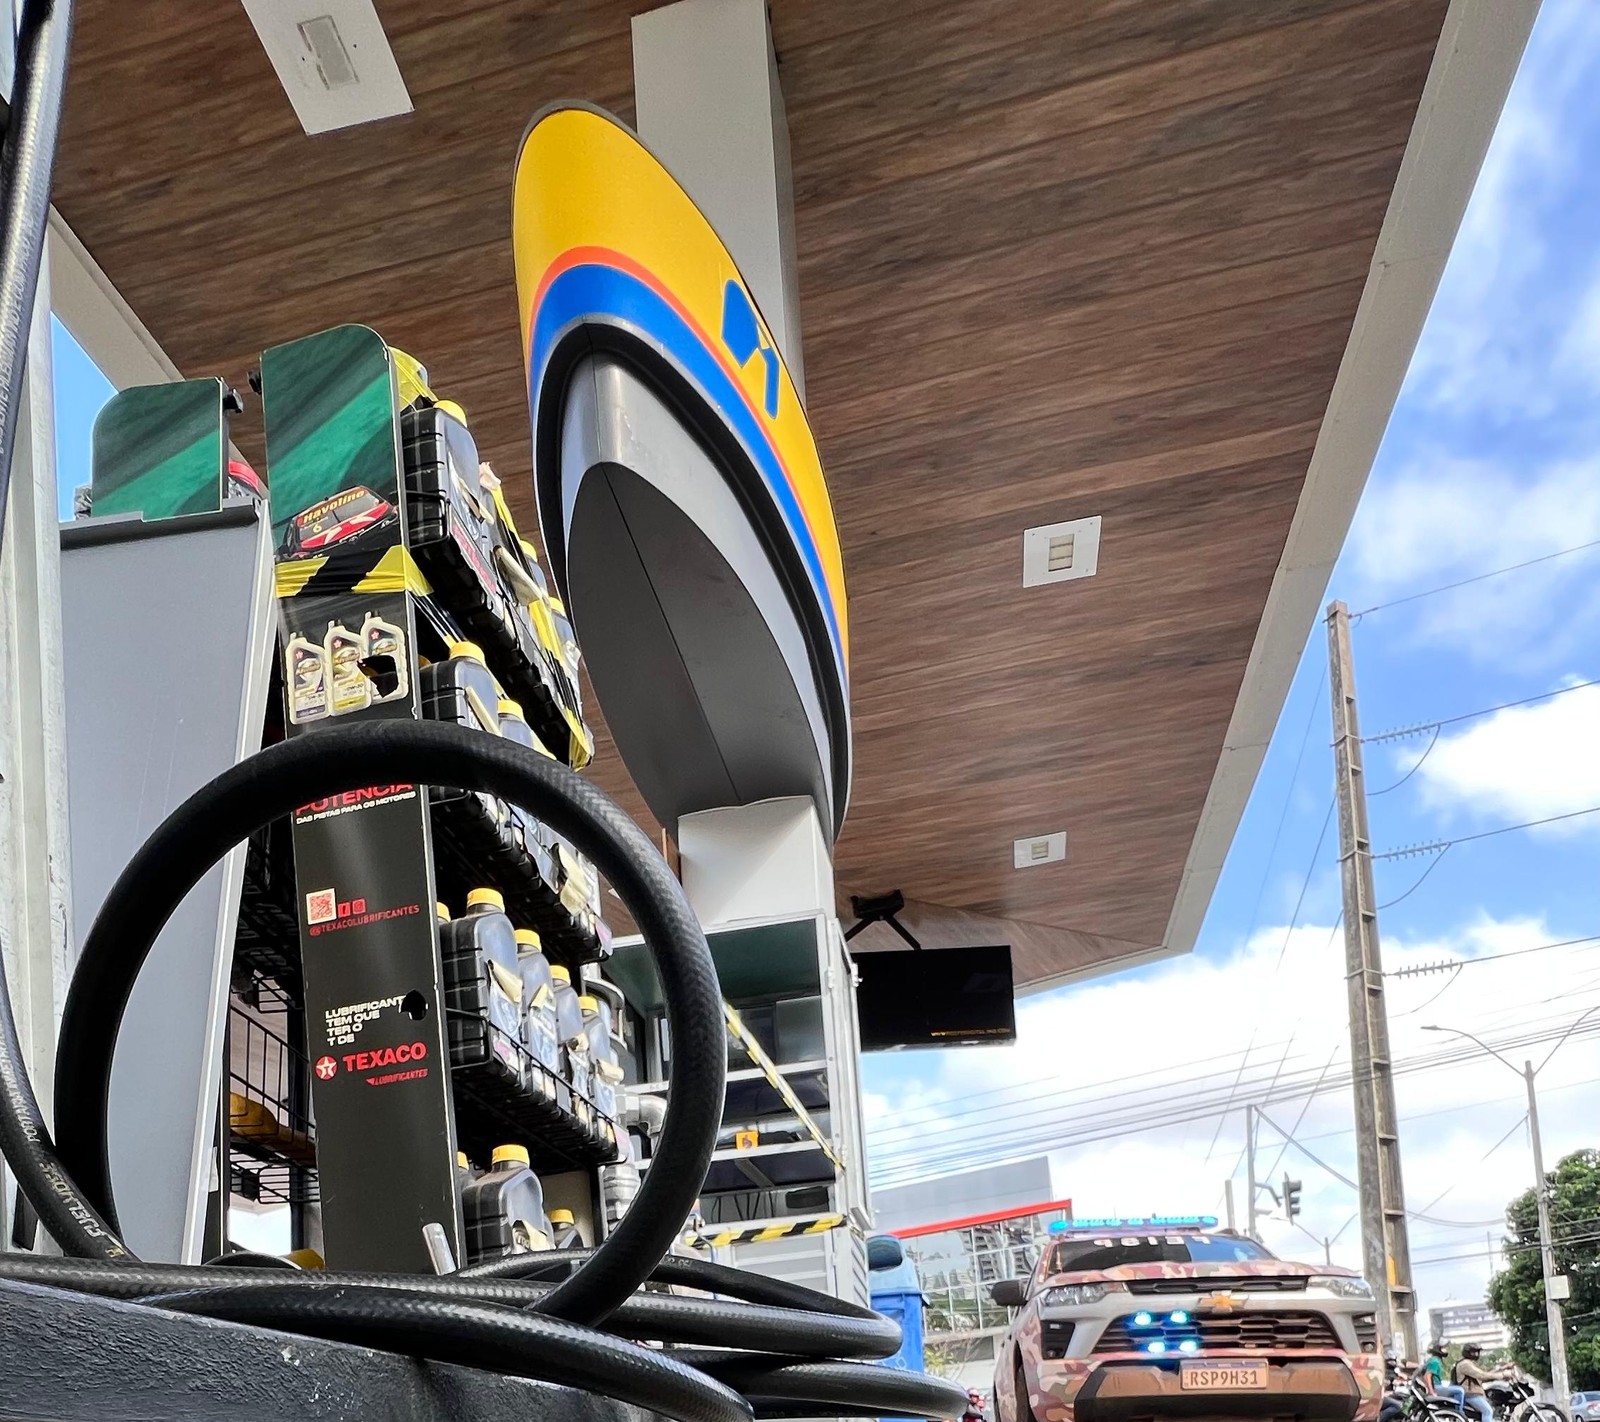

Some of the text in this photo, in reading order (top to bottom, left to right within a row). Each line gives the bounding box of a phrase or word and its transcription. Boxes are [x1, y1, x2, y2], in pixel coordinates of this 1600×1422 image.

[303, 490, 365, 524] Havoline
[313, 523, 323, 533] 6
[296, 791, 417, 824] DAS PISTAS PARA OS MOTORES
[309, 904, 420, 936] @TEXACOLUBRIFICANTES
[325, 995, 407, 1019] LUBRIFICANT
[326, 1009, 380, 1028] TEM QUE
[326, 1023, 363, 1037] TER O
[327, 1033, 355, 1047] T DE
[343, 1041, 427, 1072] TEXACO
[373, 1068, 428, 1086] LUBRIFICANTES
[1190, 1369, 1258, 1387] RSP9H31
